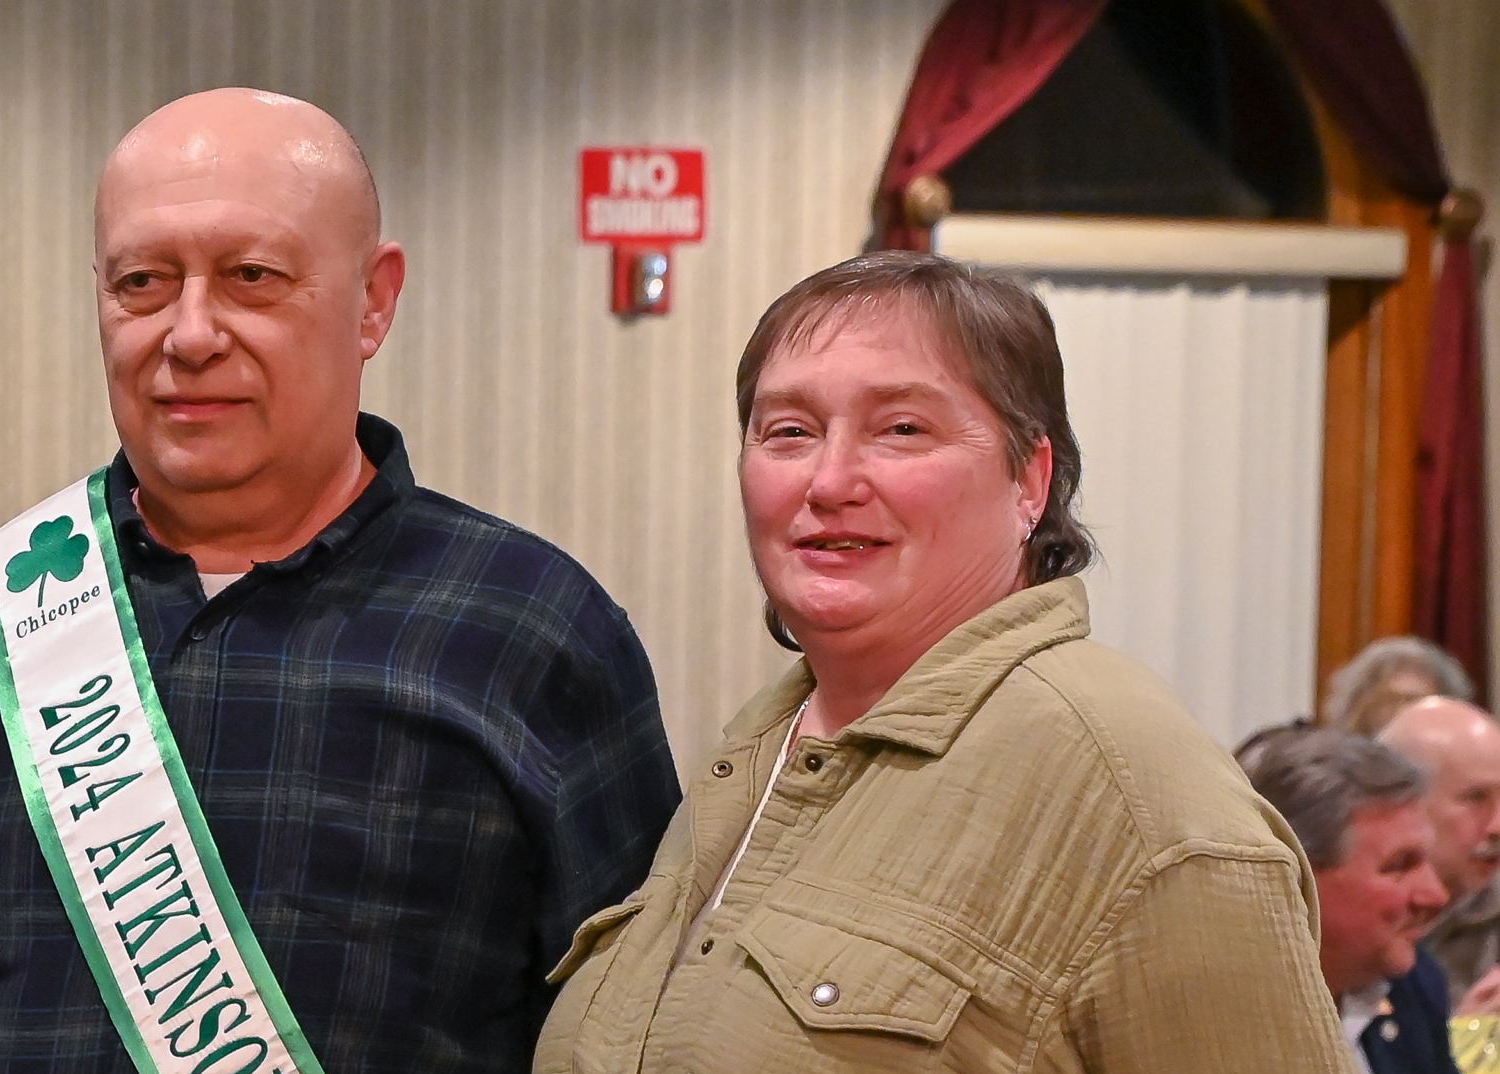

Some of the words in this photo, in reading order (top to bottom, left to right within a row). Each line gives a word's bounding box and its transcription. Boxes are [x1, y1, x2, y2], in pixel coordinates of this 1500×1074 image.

[609, 153, 679, 196] NO
[15, 583, 102, 640] Chicopee
[38, 674, 144, 823] 2024
